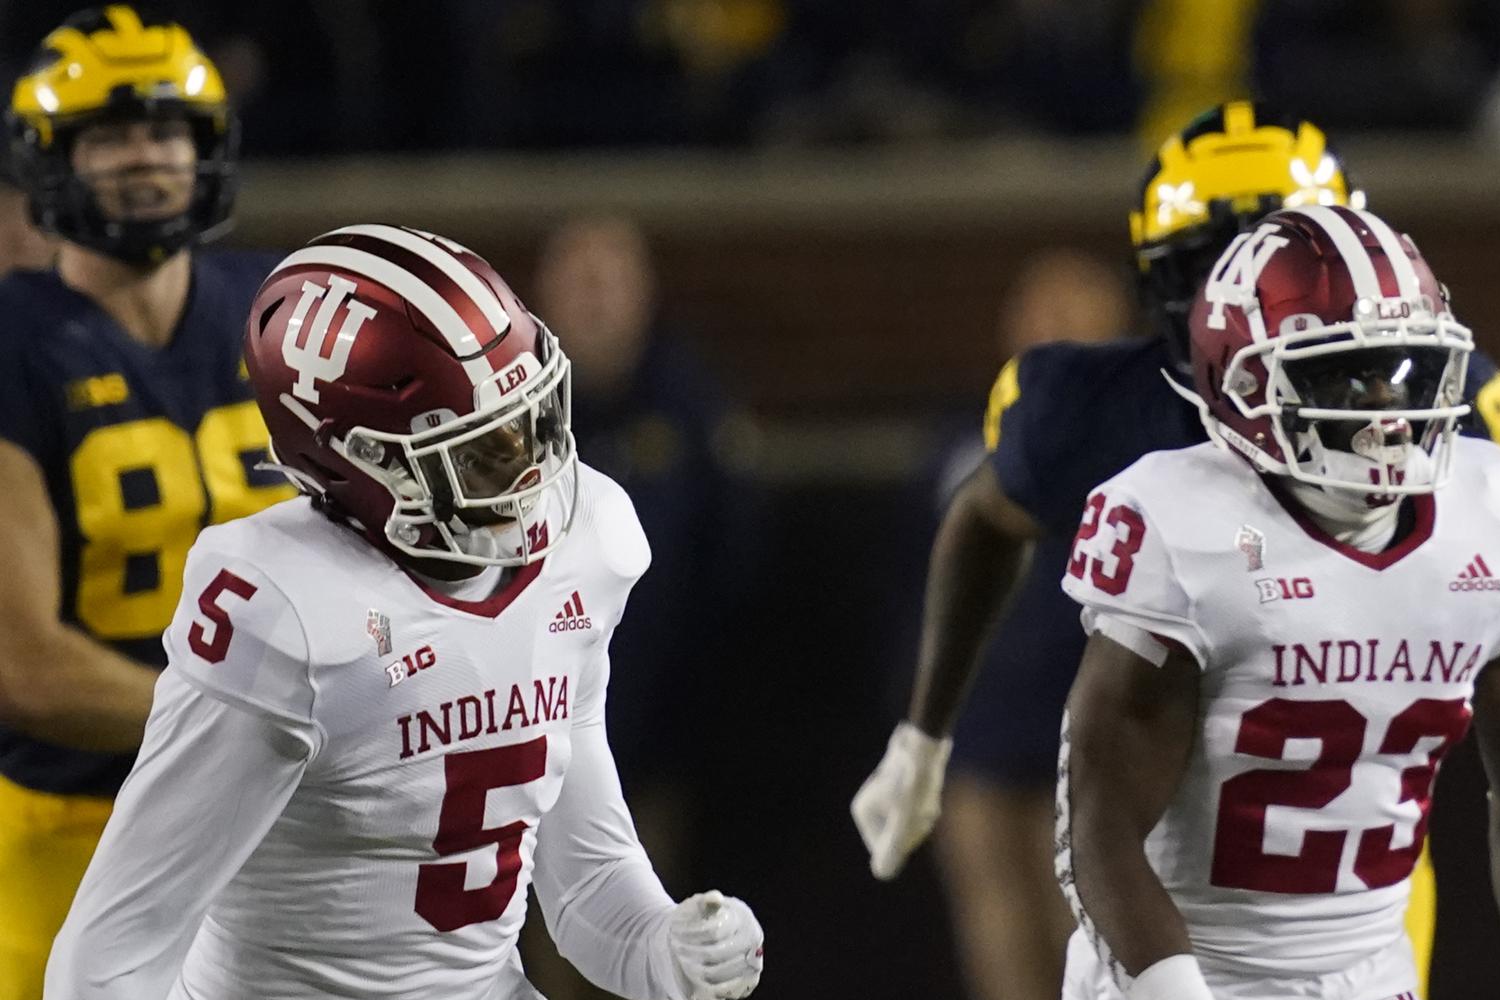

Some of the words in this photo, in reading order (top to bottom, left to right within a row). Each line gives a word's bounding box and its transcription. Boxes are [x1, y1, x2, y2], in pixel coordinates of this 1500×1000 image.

[495, 364, 528, 397] LEO
[1066, 492, 1146, 596] 23
[187, 568, 258, 664] 5
[548, 615, 592, 633] adidas
[1271, 639, 1483, 687] INDIANA
[397, 676, 568, 759] INDIANA
[414, 735, 547, 932] 5
[1210, 697, 1472, 893] 23
